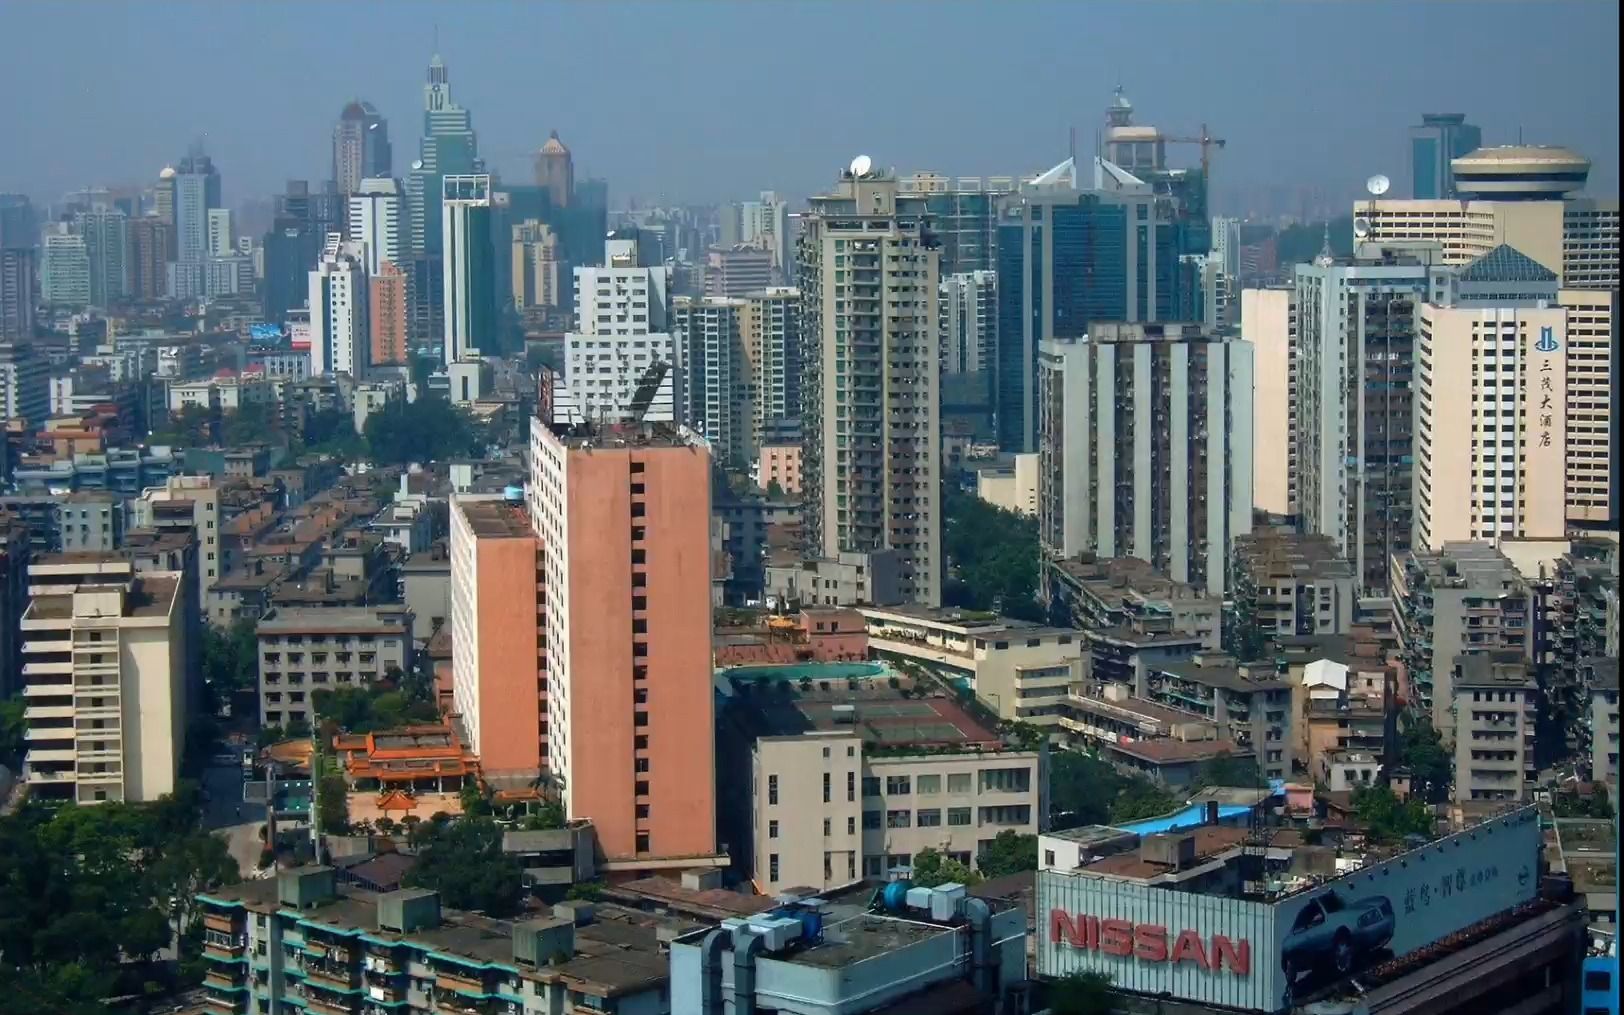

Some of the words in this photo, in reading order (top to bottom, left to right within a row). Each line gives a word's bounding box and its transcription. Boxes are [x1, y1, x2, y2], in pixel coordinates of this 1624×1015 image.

[1539, 359, 1553, 448] 三茂大酒店
[1051, 908, 1250, 976] NISSAN
